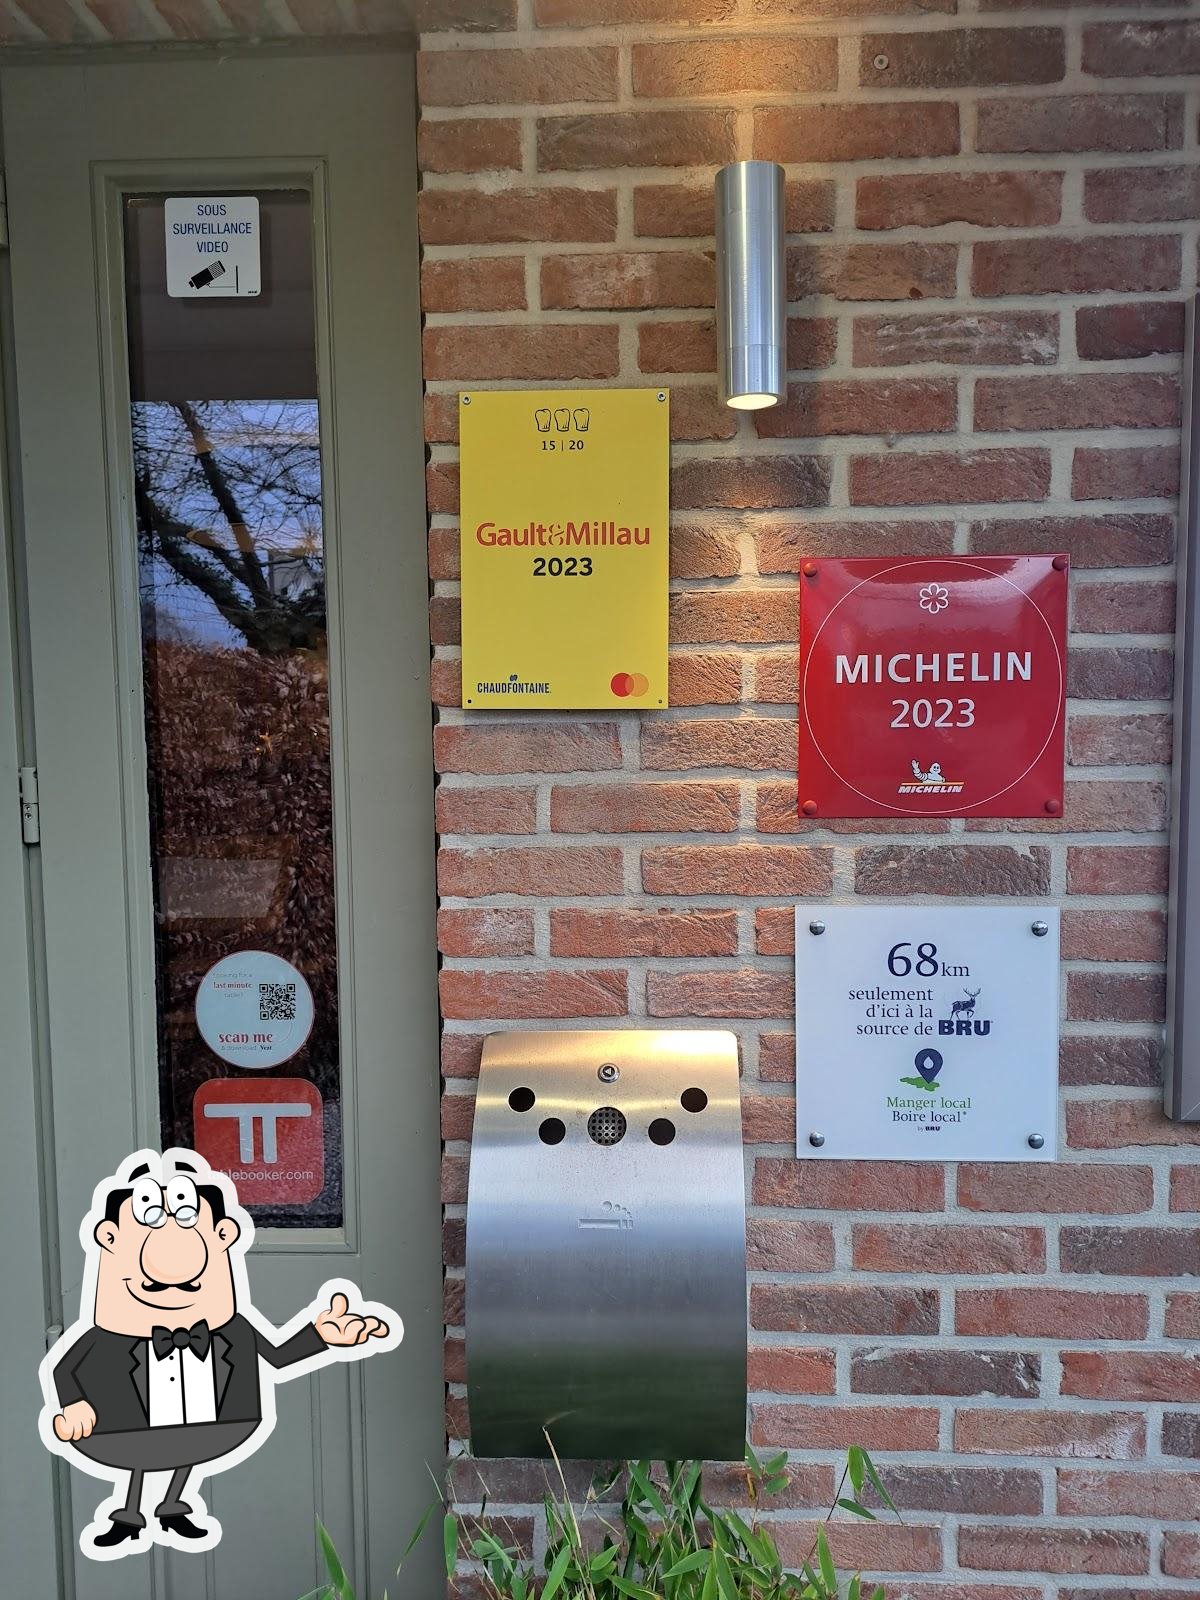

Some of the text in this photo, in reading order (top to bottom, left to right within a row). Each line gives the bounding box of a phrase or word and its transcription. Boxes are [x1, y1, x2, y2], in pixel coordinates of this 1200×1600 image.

[197, 204, 227, 216] SOUS
[172, 222, 252, 235] SURVEILLANCE
[196, 241, 229, 253] VIDEO
[541, 440, 556, 450] 15
[568, 440, 584, 450] 20
[476, 521, 650, 546] Gault&Millau
[532, 557, 593, 577] 2023
[835, 651, 1032, 684] MICHELIN
[477, 682, 550, 694] CHAUDFONTAINE
[890, 698, 976, 728] 2023
[898, 785, 964, 794] MICHELIN
[887, 942, 970, 977] 68 km
[848, 986, 934, 1001] seulement
[905, 1004, 914, 1018] à
[919, 1004, 933, 1018] la
[856, 1019, 991, 1036] source de BRU
[218, 1033, 273, 1043] scan me
[886, 1096, 972, 1111] Manger local
[892, 1110, 926, 1122] Boire
[220, 1169, 314, 1181] lebooker.com
